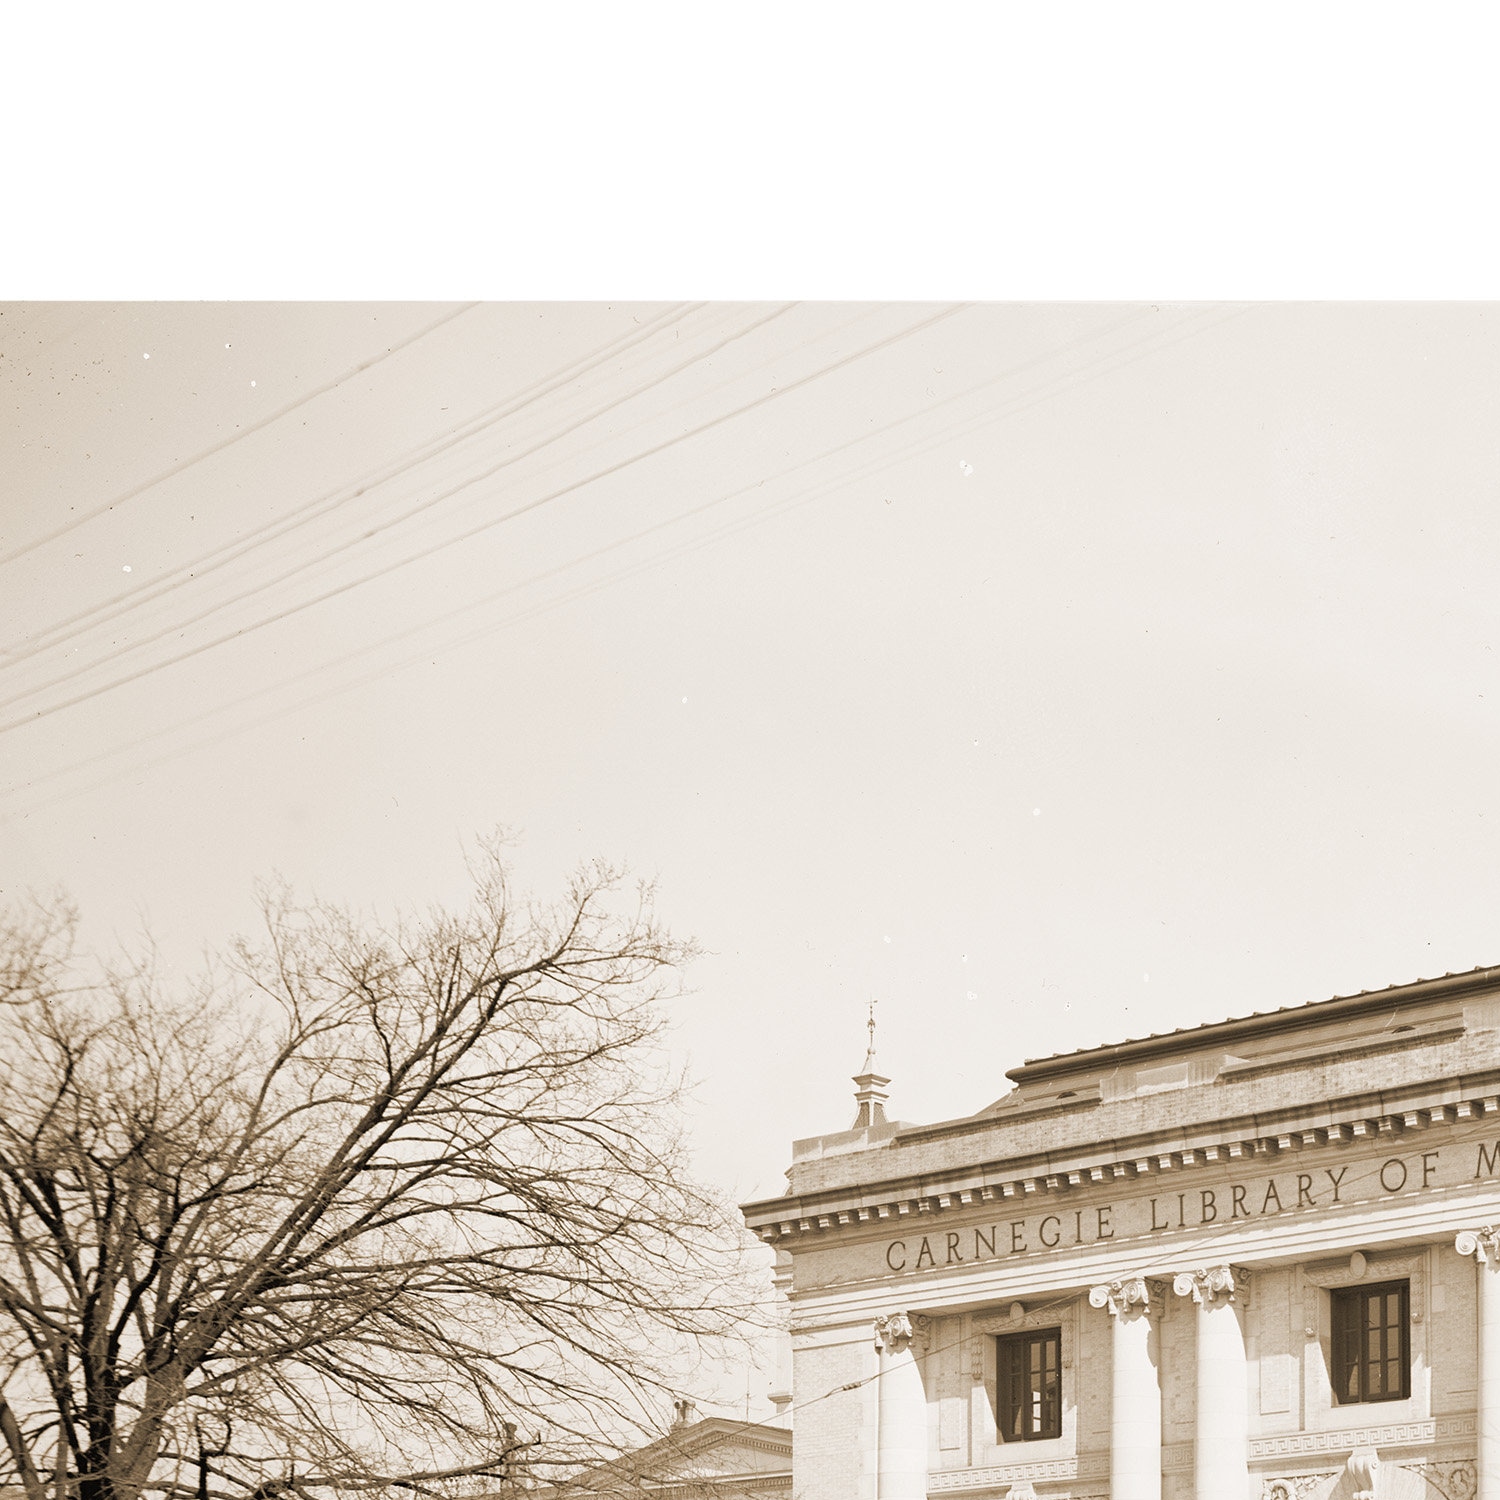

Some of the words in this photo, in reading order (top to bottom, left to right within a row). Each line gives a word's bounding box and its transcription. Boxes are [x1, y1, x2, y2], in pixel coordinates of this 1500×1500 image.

[886, 1206, 1115, 1271] CARNEGIE
[1150, 1167, 1348, 1231] LIBRARY
[1379, 1151, 1440, 1193] OF
